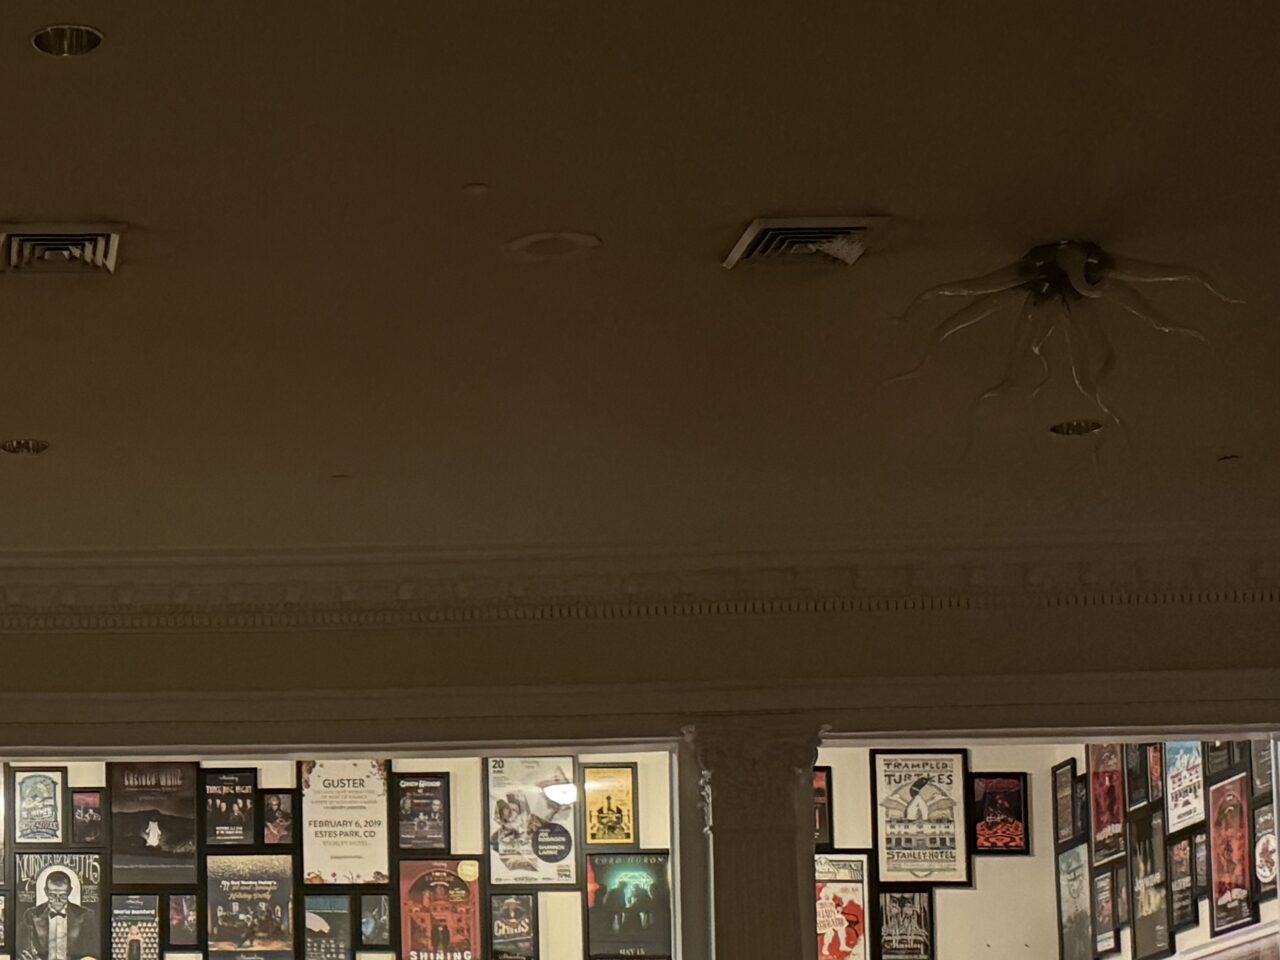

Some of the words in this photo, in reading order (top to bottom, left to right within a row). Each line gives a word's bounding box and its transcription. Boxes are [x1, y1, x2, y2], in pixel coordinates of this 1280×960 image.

[491, 759, 504, 769] 20
[322, 778, 366, 789] GUSTER
[884, 774, 953, 785] TURTLES
[308, 820, 353, 828] FEBRUARY
[364, 820, 382, 828] 2019
[314, 830, 338, 838] ESTES
[363, 830, 376, 838] CO
[409, 950, 472, 960] SHINING
